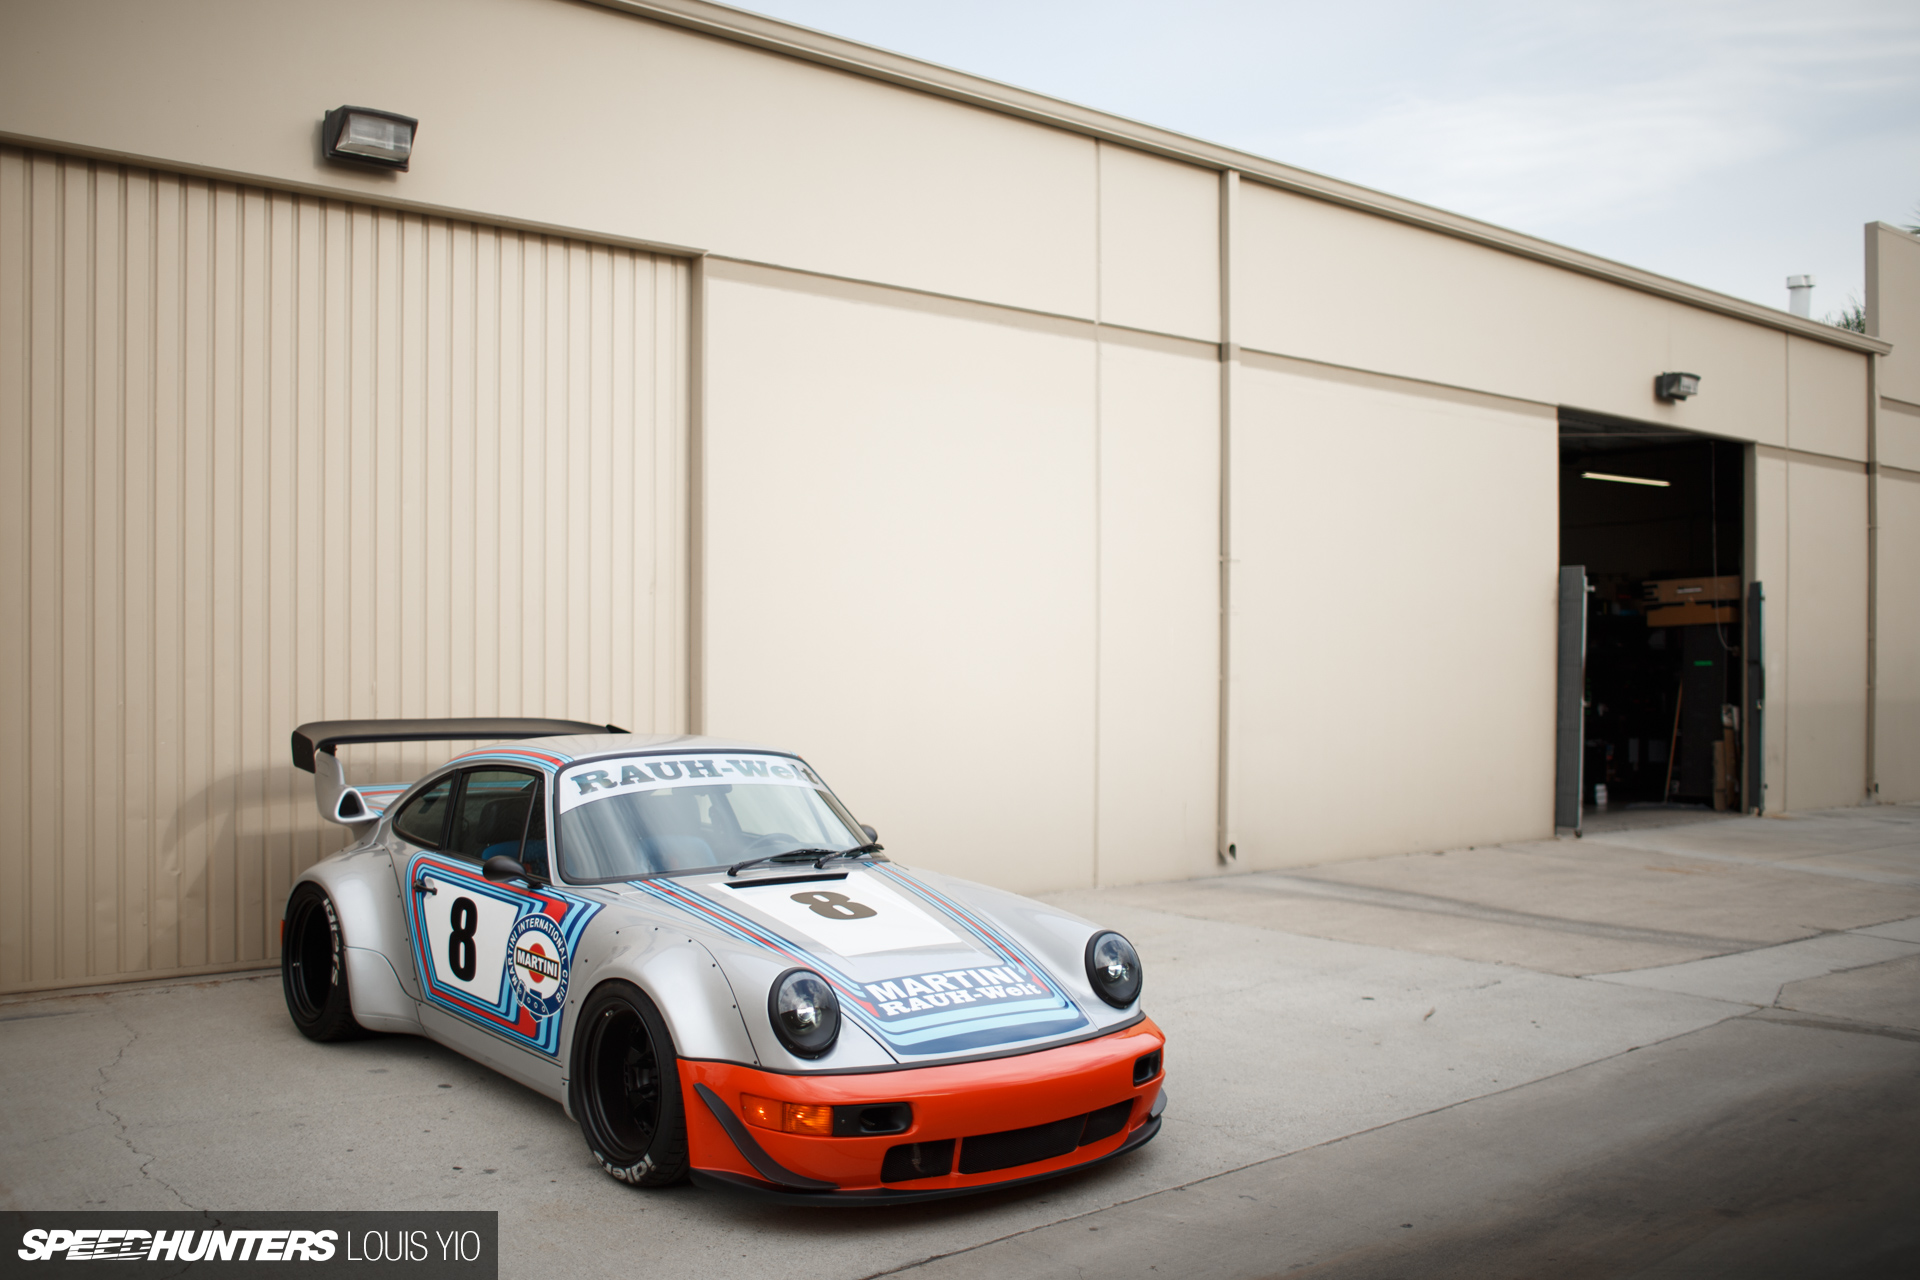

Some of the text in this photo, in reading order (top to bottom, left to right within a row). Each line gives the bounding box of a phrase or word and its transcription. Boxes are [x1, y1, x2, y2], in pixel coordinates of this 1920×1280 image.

[570, 758, 820, 796] RAUH-Welt
[790, 890, 878, 921] 8
[448, 896, 478, 982] 8
[507, 917, 569, 1003] MARTINI INTERNATIONAL CLUB
[517, 949, 558, 978] MARTINI
[864, 966, 1025, 1002] MARTINI
[878, 982, 1042, 1017] RAUH-Welt
